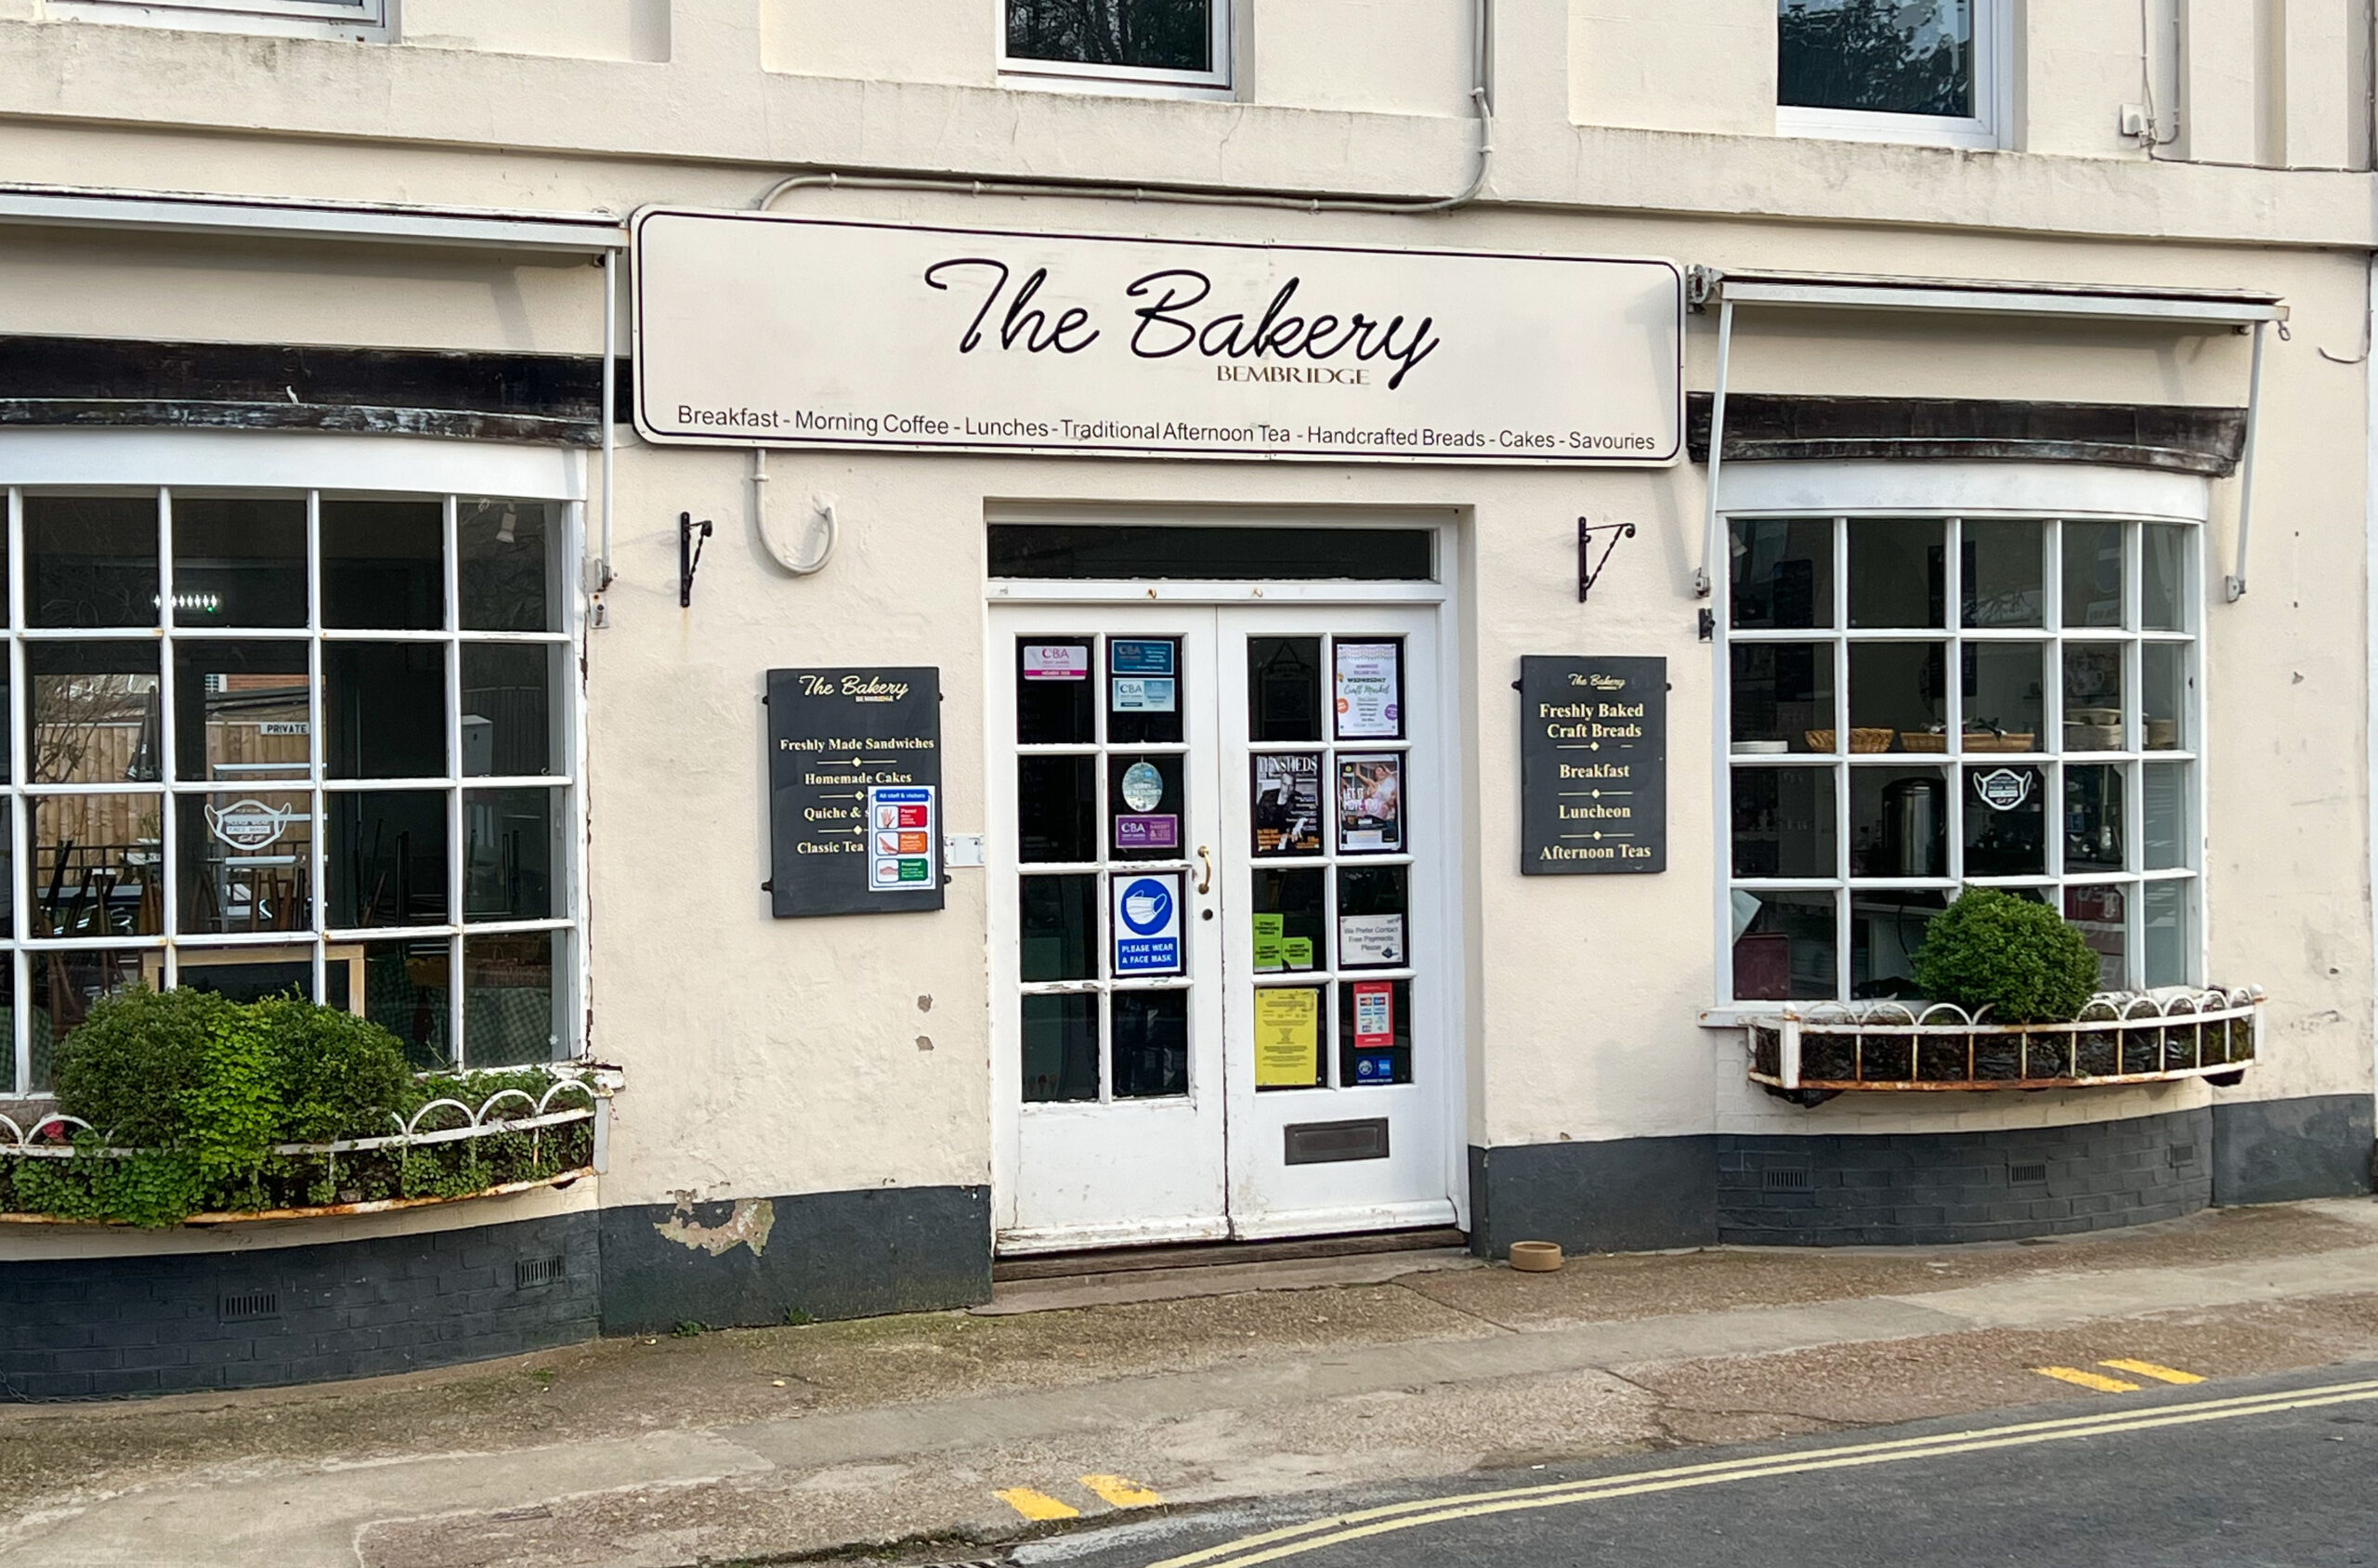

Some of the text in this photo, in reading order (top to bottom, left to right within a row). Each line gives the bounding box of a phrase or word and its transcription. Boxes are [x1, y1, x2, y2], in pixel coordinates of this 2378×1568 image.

[923, 256, 1441, 391] The Bakery
[1216, 364, 1371, 385] BEMBRIDGE
[677, 405, 779, 428] Breakfast
[795, 410, 879, 437] Morning
[882, 413, 950, 435] Coffee
[965, 417, 1049, 438] Lunches
[1061, 419, 1160, 440] Traditional
[1162, 422, 1254, 442] Afternoon
[1258, 425, 1291, 442] Tea
[1307, 425, 1418, 446] Handcrafted
[1422, 428, 1486, 447] Breads
[1499, 430, 1555, 449] Cakes
[1568, 431, 1656, 451] Savouries
[1041, 647, 1070, 659] CBA
[798, 674, 909, 700] The Bakery
[1119, 684, 1143, 694] CBA
[1539, 702, 1644, 721] Freshly Baked
[267, 724, 307, 734] PRIVATE
[1547, 722, 1642, 738] Craft Breads
[779, 737, 935, 753] Freshly Made Sandwiches
[804, 771, 912, 785] Homemade Cakes
[1559, 764, 1630, 778] Breakfast
[804, 807, 847, 822] Quiche
[849, 807, 862, 818] &
[1559, 804, 1631, 819] Luncheon
[1121, 822, 1146, 833] CBA
[796, 841, 865, 854] Classic Tea
[1539, 843, 1652, 860] Afternoon Teas
[1121, 942, 1174, 953] PLEASE WEAR
[1121, 954, 1172, 964] A FACE MASK
